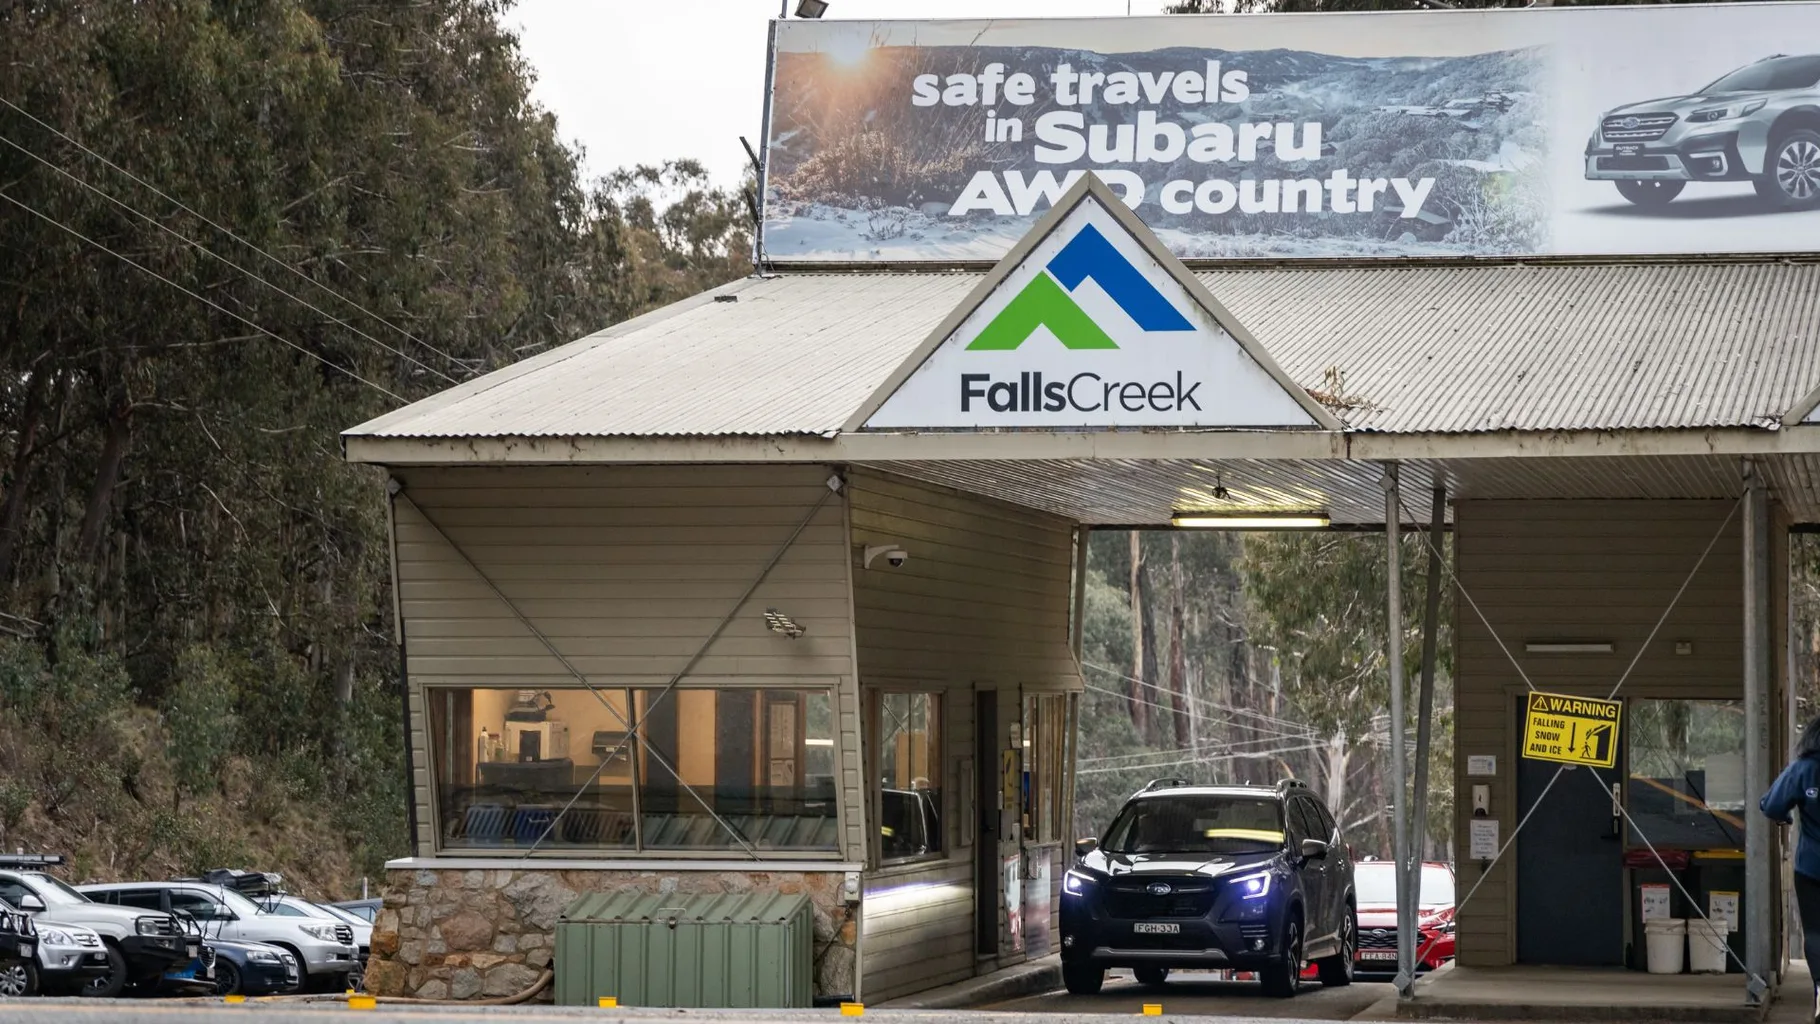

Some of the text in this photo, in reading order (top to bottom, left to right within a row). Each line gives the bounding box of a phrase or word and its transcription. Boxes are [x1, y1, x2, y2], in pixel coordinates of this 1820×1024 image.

[911, 59, 1250, 107] safe travels
[984, 110, 1322, 164] in Subaru
[1159, 168, 1437, 219] country
[960, 370, 1202, 413] FallsCreek
[1533, 717, 1565, 729] FALLING
[1550, 698, 1616, 718] WARNING
[1530, 743, 1562, 755] AND ICE
[1535, 730, 1560, 741] SNOW
